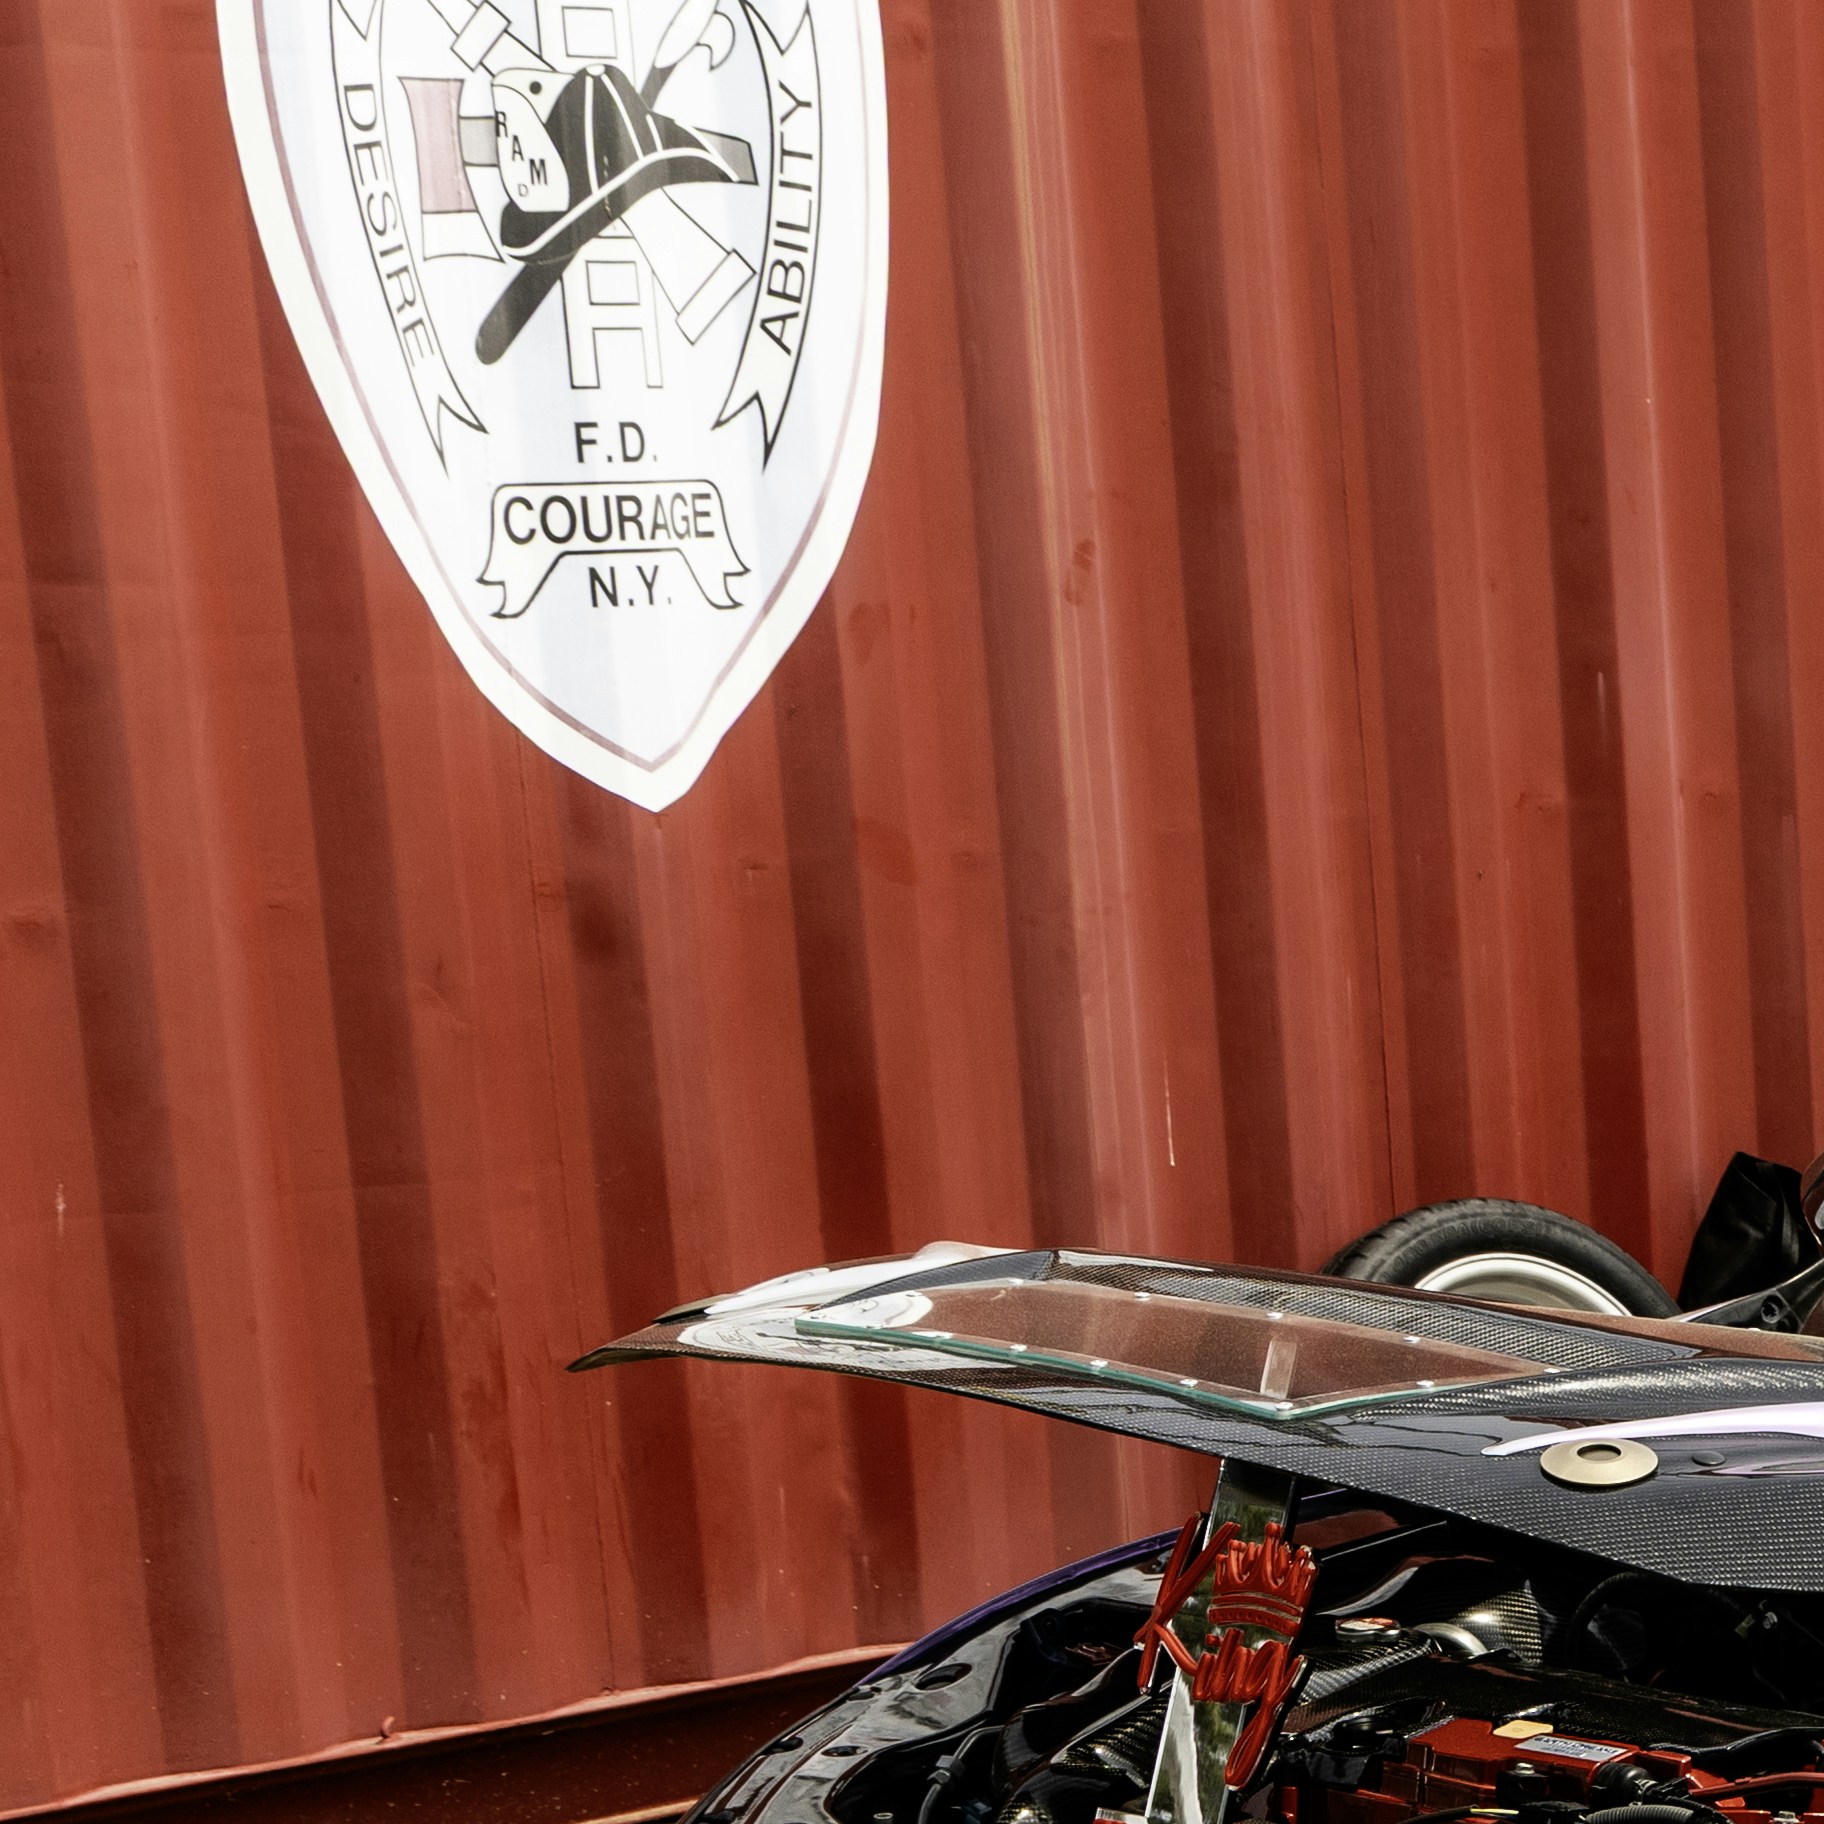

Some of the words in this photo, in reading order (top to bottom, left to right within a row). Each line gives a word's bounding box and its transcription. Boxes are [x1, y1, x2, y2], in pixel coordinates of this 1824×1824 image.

[342, 82, 435, 369] DESIRE
[758, 80, 814, 356] ABILITY
[574, 421, 659, 464] F.D.
[503, 494, 716, 546] COURAGE
[588, 564, 672, 609] N.Y.
